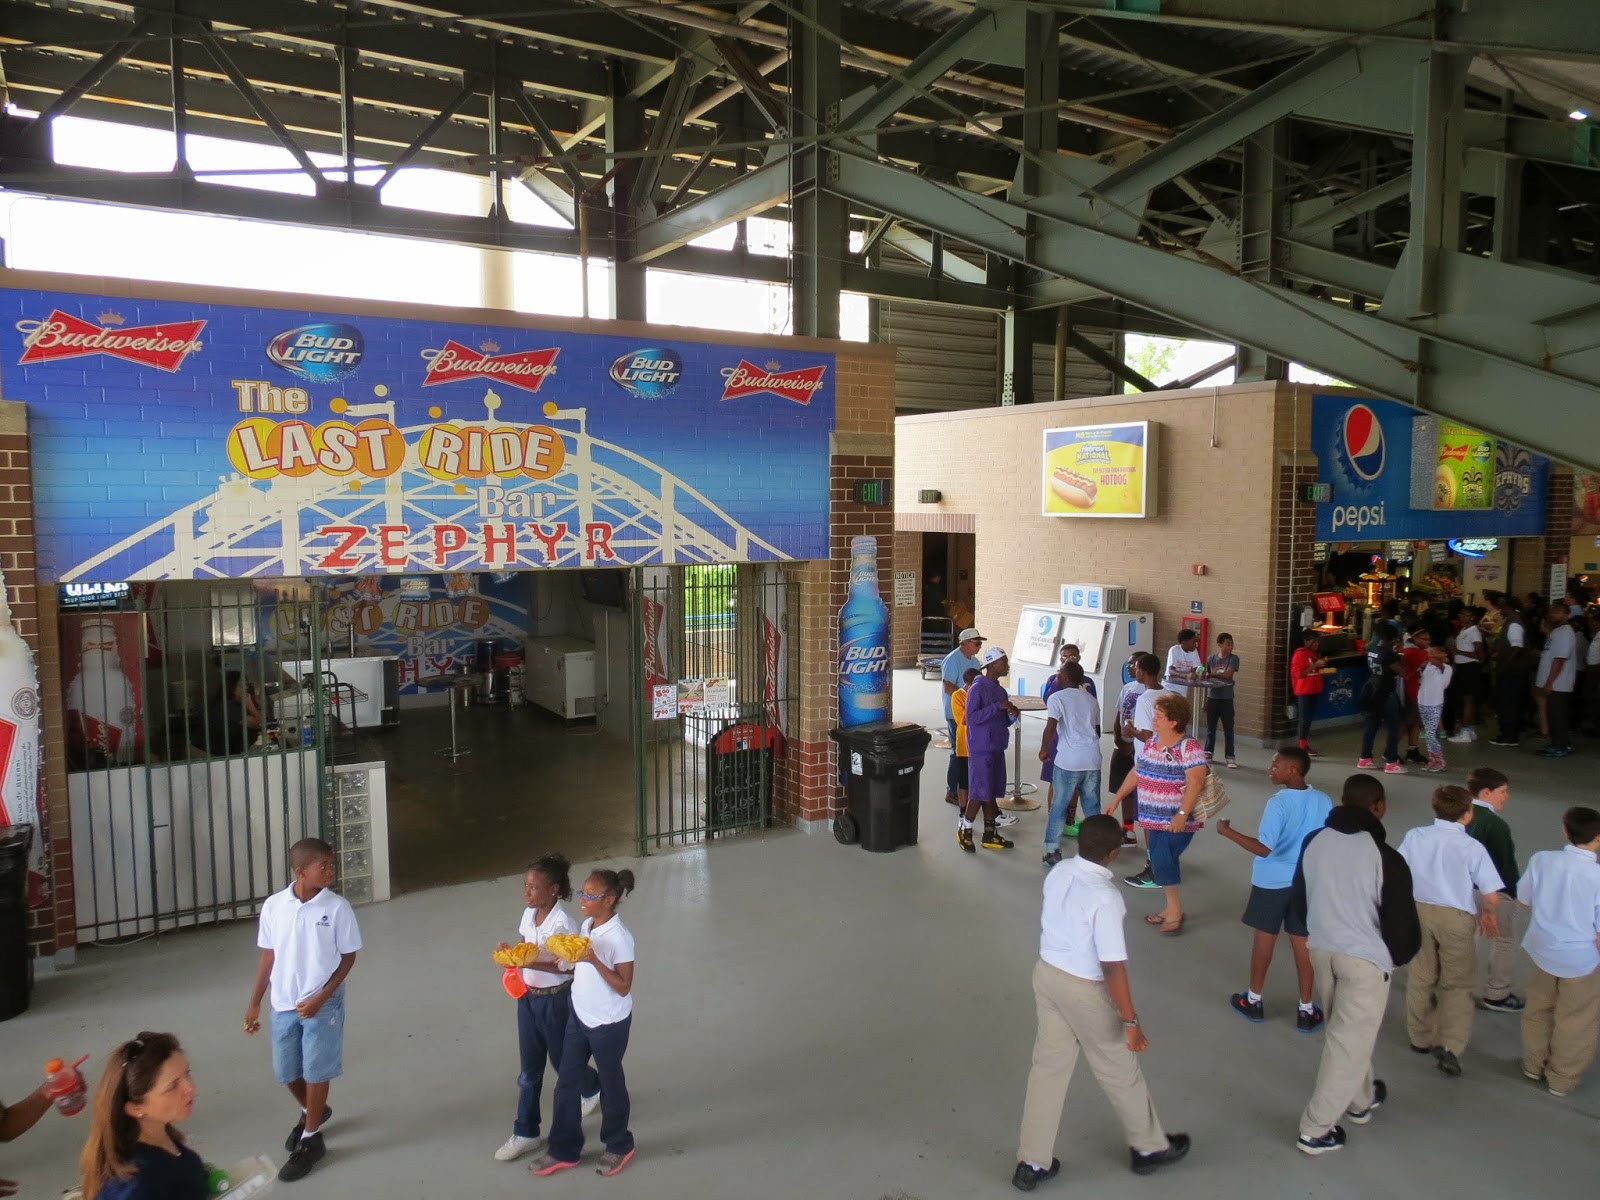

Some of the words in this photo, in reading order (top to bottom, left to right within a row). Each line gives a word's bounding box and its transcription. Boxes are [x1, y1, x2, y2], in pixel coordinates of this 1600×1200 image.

[15, 319, 203, 354] Budweiser
[295, 334, 354, 350] BUD
[281, 347, 361, 364] LIGHT
[420, 347, 556, 376] Budweiser
[630, 356, 674, 371] BUD
[621, 367, 680, 383] LIGHT
[720, 366, 823, 392] Budweiser
[231, 380, 308, 414] The
[236, 424, 392, 472] LAST
[425, 425, 554, 474] RIDE
[1077, 452, 1110, 460] NATIONAL
[1100, 474, 1127, 485] HOTDOG
[1496, 471, 1530, 496] EPHYRS
[863, 483, 878, 502] EXIT
[1307, 486, 1325, 500] EXIT
[476, 485, 556, 520] Bar
[1332, 501, 1385, 532] pepsi
[315, 521, 616, 571] ZEPHYR
[1455, 543, 1498, 551] LIGHT
[894, 572, 915, 580] NOTICE
[1064, 588, 1099, 608] ICE
[396, 600, 482, 631] RIDE
[407, 636, 455, 656] Bar
[845, 646, 886, 660] BUD
[838, 660, 888, 675] LIGHT
